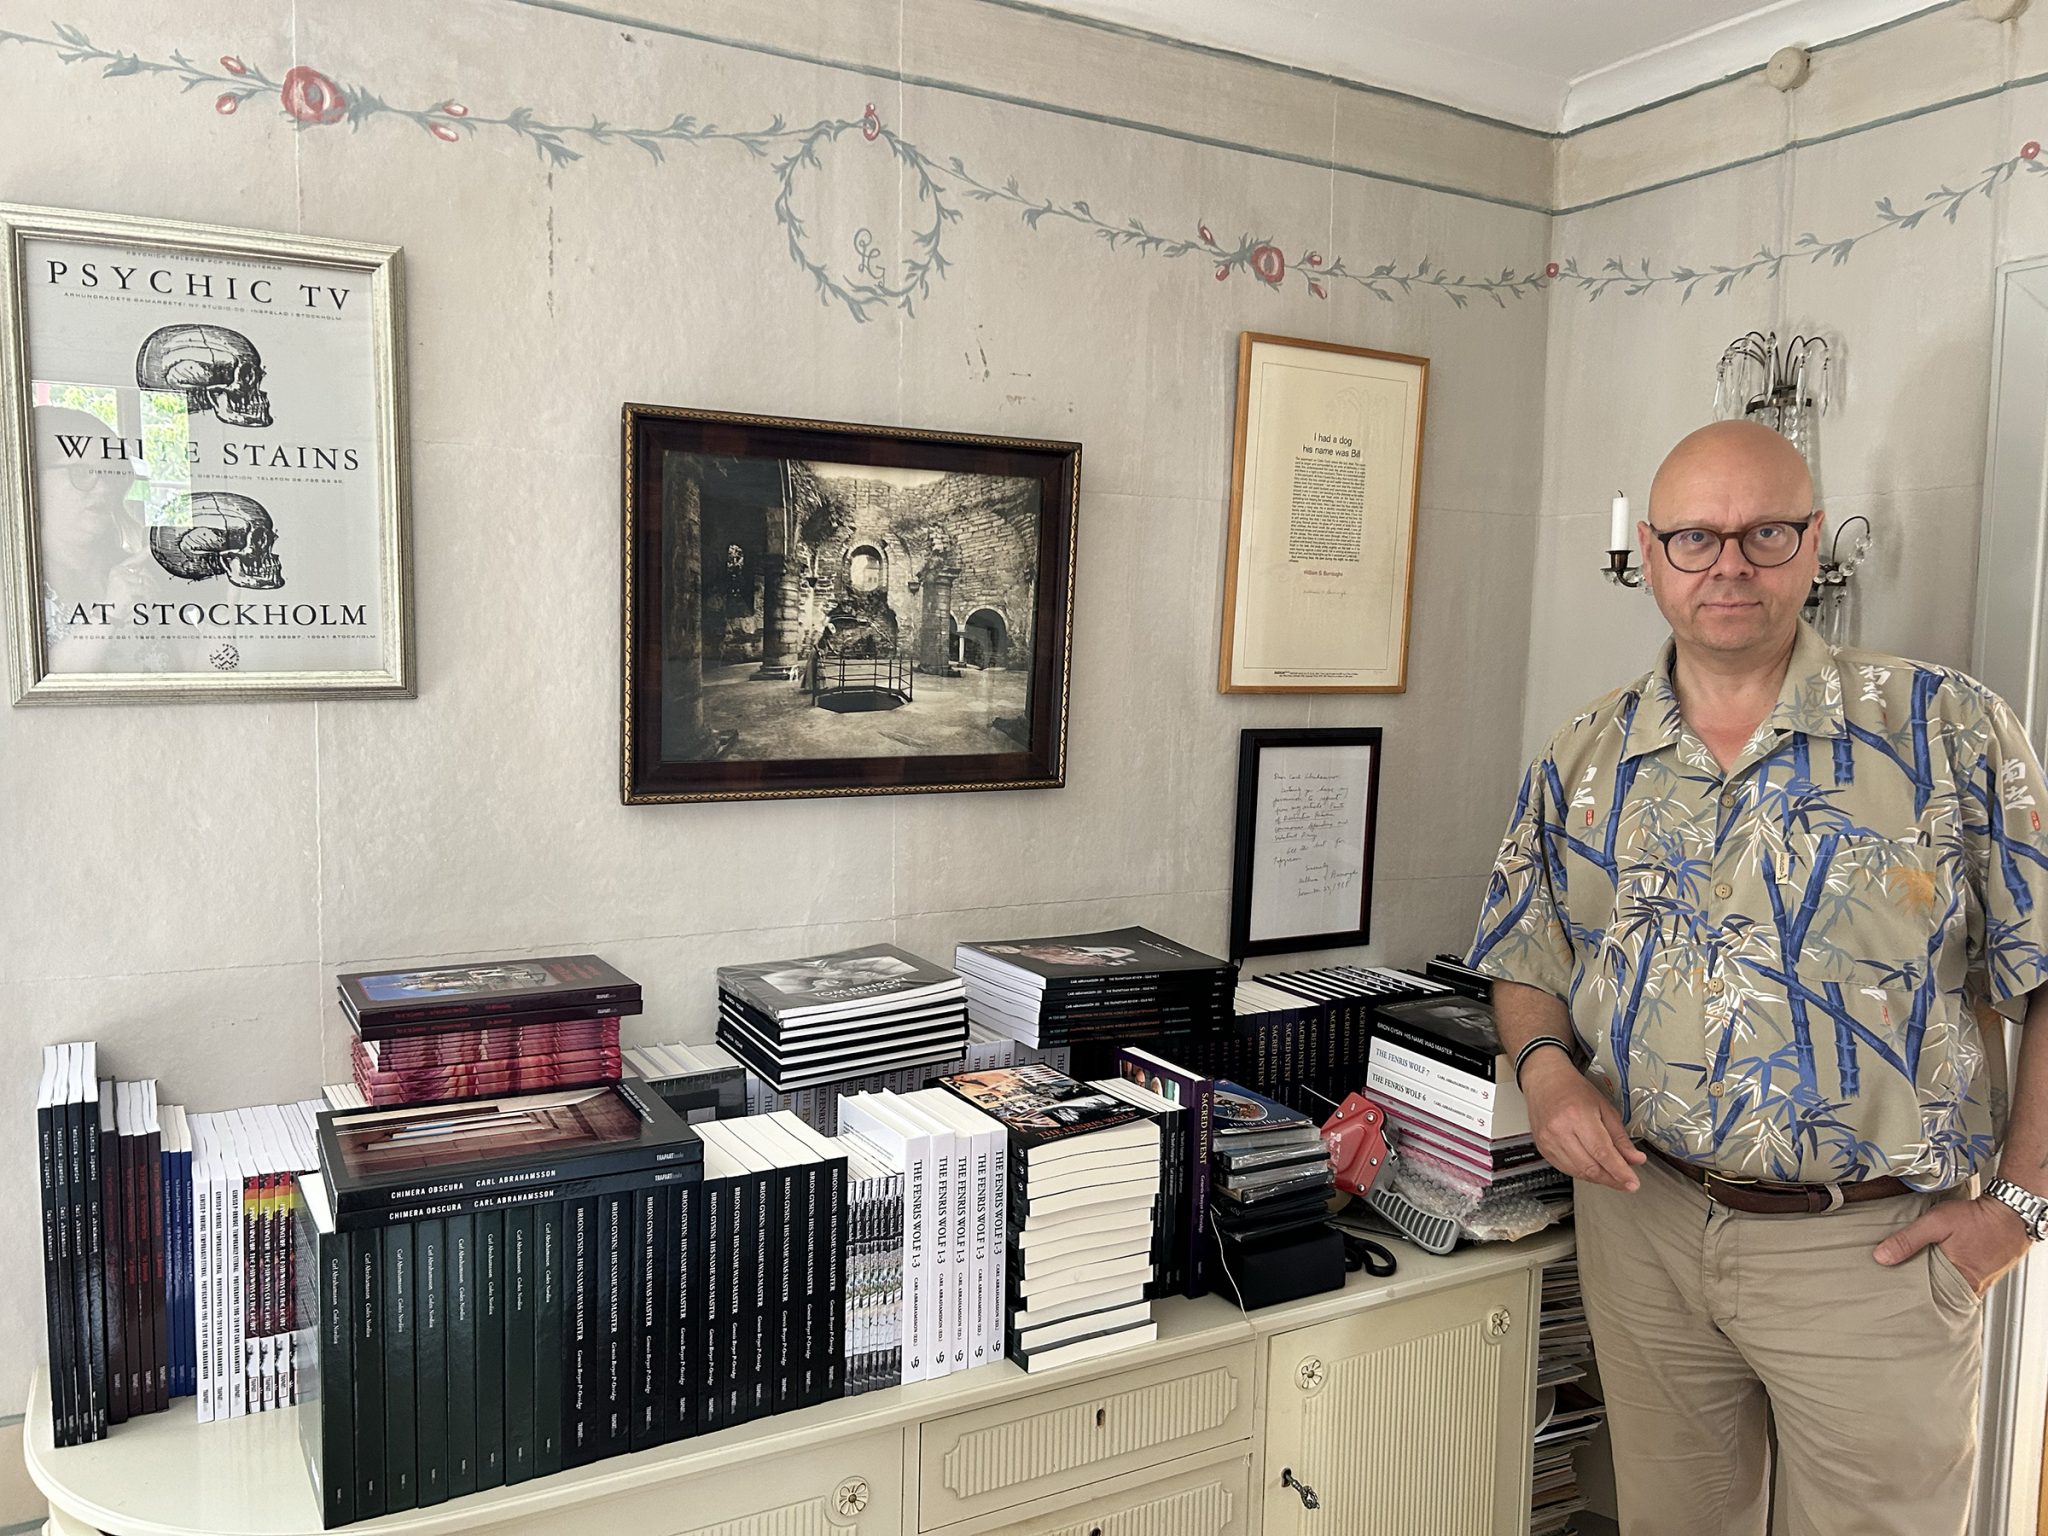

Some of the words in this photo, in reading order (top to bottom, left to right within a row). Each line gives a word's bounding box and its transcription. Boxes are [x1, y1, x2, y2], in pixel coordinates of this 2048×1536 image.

[47, 260, 273, 304] PSYCHIC
[299, 284, 350, 311] TV
[296, 312, 342, 321] STOCKHOLM
[1303, 445, 1313, 453] his
[1315, 448, 1334, 456] name
[1314, 432, 1317, 441] I
[1318, 433, 1331, 443] had
[1339, 436, 1353, 447] dog
[223, 442, 359, 471] STAINS
[67, 602, 116, 625] AT
[133, 602, 367, 626] STOCKHOLM
[1258, 1026, 1266, 1056] SACRED
[1424, 1040, 1435, 1049] WAS
[1434, 1043, 1453, 1056] MASTER
[1376, 1048, 1387, 1060] THE
[1388, 1053, 1408, 1067] FENRIS
[1408, 1061, 1426, 1074] WOLF
[1426, 1069, 1431, 1077] 7
[1372, 1073, 1384, 1085] THE
[1384, 1078, 1404, 1093] FENRIS
[1404, 1086, 1423, 1100] WOLF
[1422, 1094, 1427, 1102] 6
[1200, 1093, 1209, 1128] SACRED
[1061, 1118, 1103, 1134] FENRIS
[995, 1150, 1004, 1171] THE
[1199, 1130, 1208, 1164] INTENT
[913, 1160, 923, 1182] THE
[938, 1156, 948, 1178] THE
[958, 1156, 967, 1177] THE
[977, 1154, 987, 1175] THE
[391, 1187, 426, 1199] CHIMERA
[428, 1182, 464, 1194] OBSCURA
[475, 1179, 496, 1188] CARL
[499, 1169, 556, 1184] ABRAHAMSSON
[938, 1181, 948, 1216] FENRIS
[957, 1181, 967, 1215] FENRIS
[977, 1178, 986, 1212] FENRIS
[994, 1173, 1004, 1208] FENRIS
[389, 1207, 424, 1220] CHIMERA
[426, 1203, 462, 1215] OBSCURA
[474, 1200, 494, 1208] CARL
[497, 1190, 555, 1204] ABRAHAMSSON
[912, 1184, 922, 1220] FENRIS
[912, 1221, 922, 1251] WOLF
[937, 1217, 947, 1247] WOLF
[956, 1217, 966, 1246] WOLF
[976, 1213, 986, 1243] WOLF
[994, 1209, 1003, 1238] WOLF
[911, 1255, 921, 1268] 1-3
[937, 1251, 946, 1264] 1-3
[956, 1250, 965, 1263] 1-3
[975, 1246, 985, 1259] 1-3
[993, 1242, 1003, 1254] 1-3
[576, 1273, 584, 1293] NAME
[576, 1294, 584, 1309] WAS
[576, 1311, 584, 1341] MASTER
